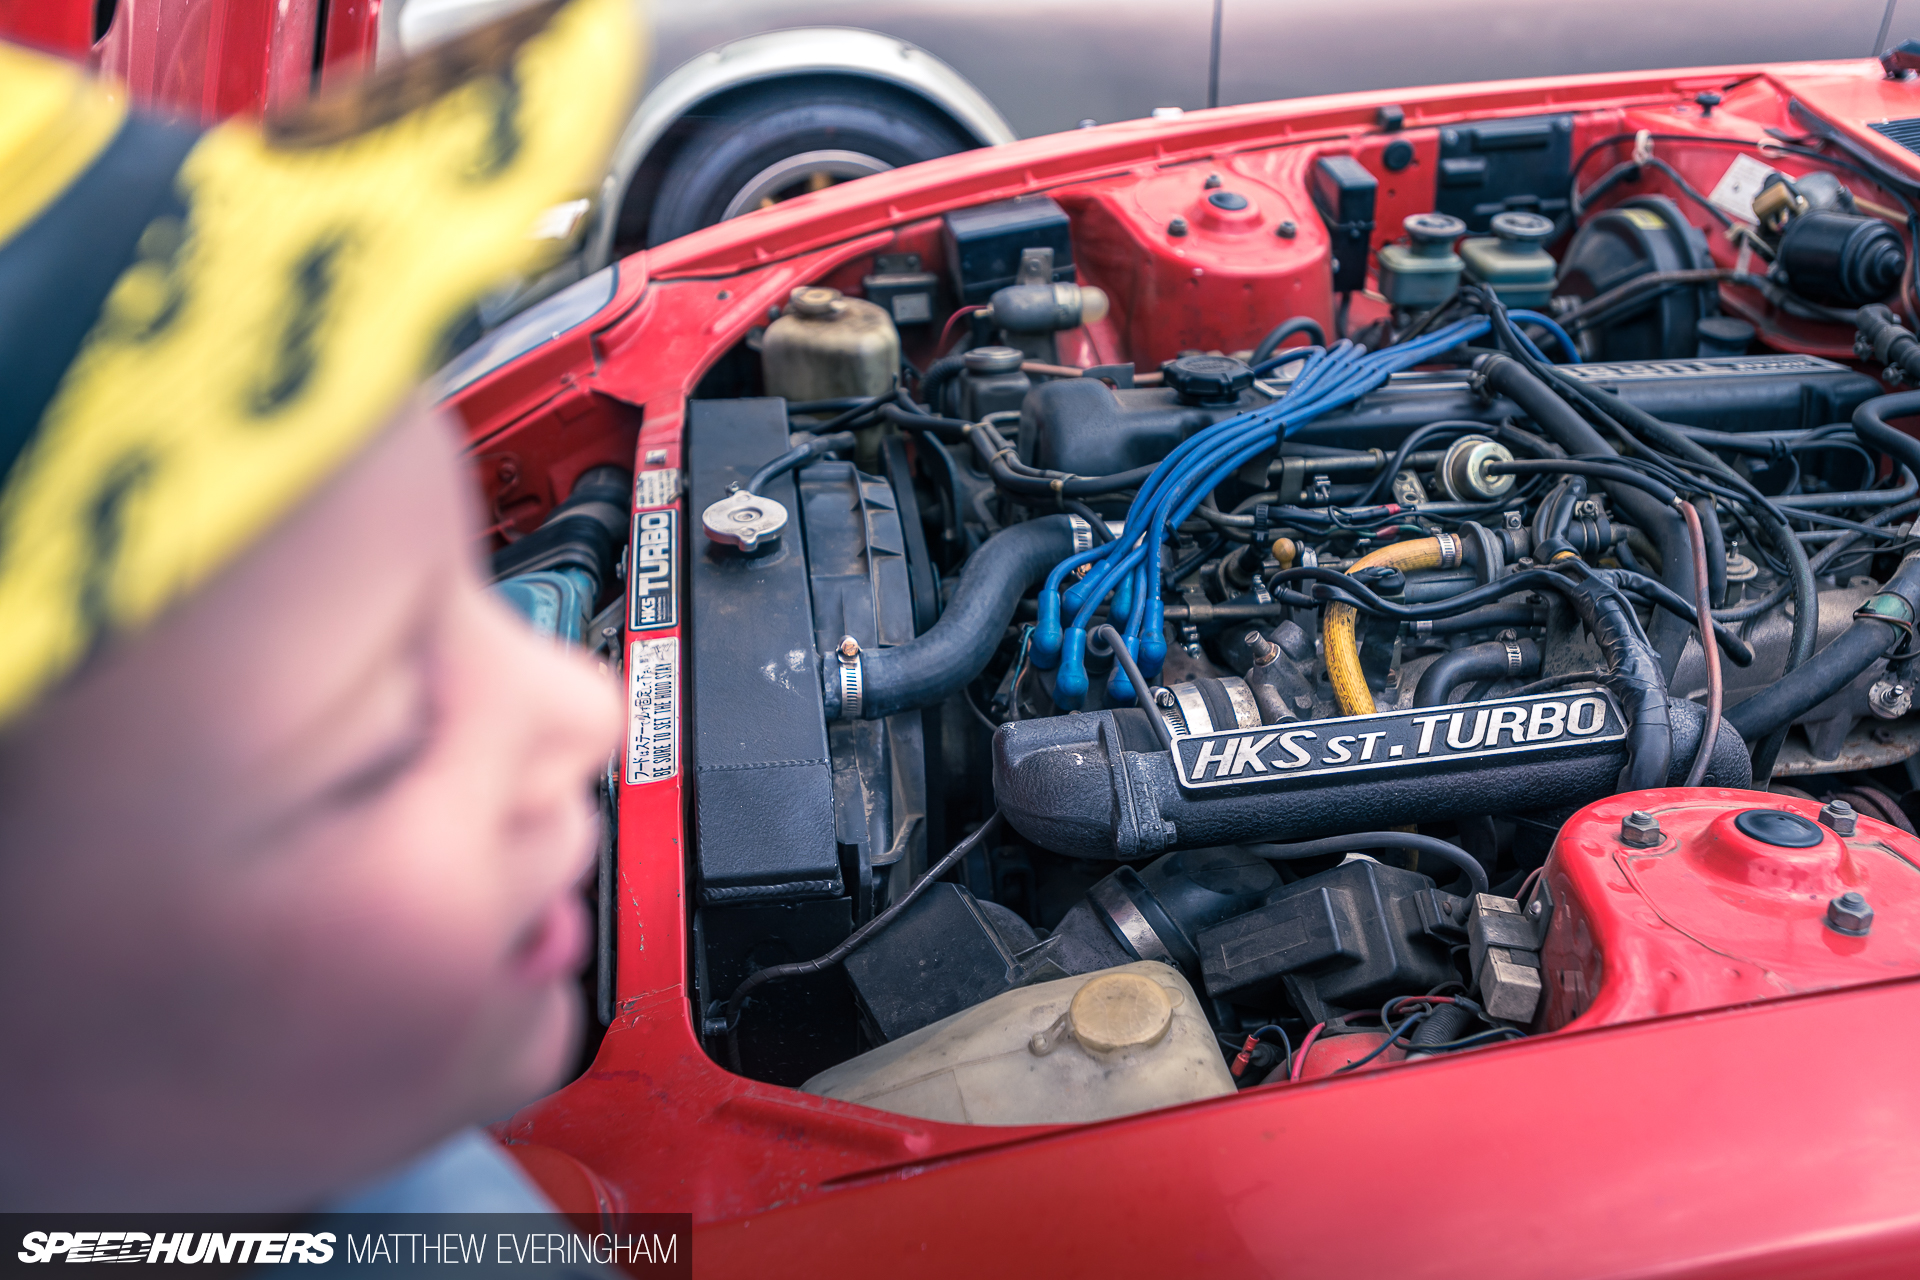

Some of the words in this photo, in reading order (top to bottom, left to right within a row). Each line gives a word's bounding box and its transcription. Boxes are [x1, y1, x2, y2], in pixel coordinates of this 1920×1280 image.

[639, 512, 670, 596] TURBO
[640, 597, 656, 623] HKS
[654, 662, 672, 680] STAY
[654, 681, 672, 699] HOOD
[654, 701, 672, 715] THE
[653, 717, 672, 730] SET
[653, 731, 672, 743] TO
[1190, 729, 1317, 780] HKS
[1413, 697, 1607, 756] TURBO
[653, 743, 672, 764] SURE
[653, 765, 672, 777] BE
